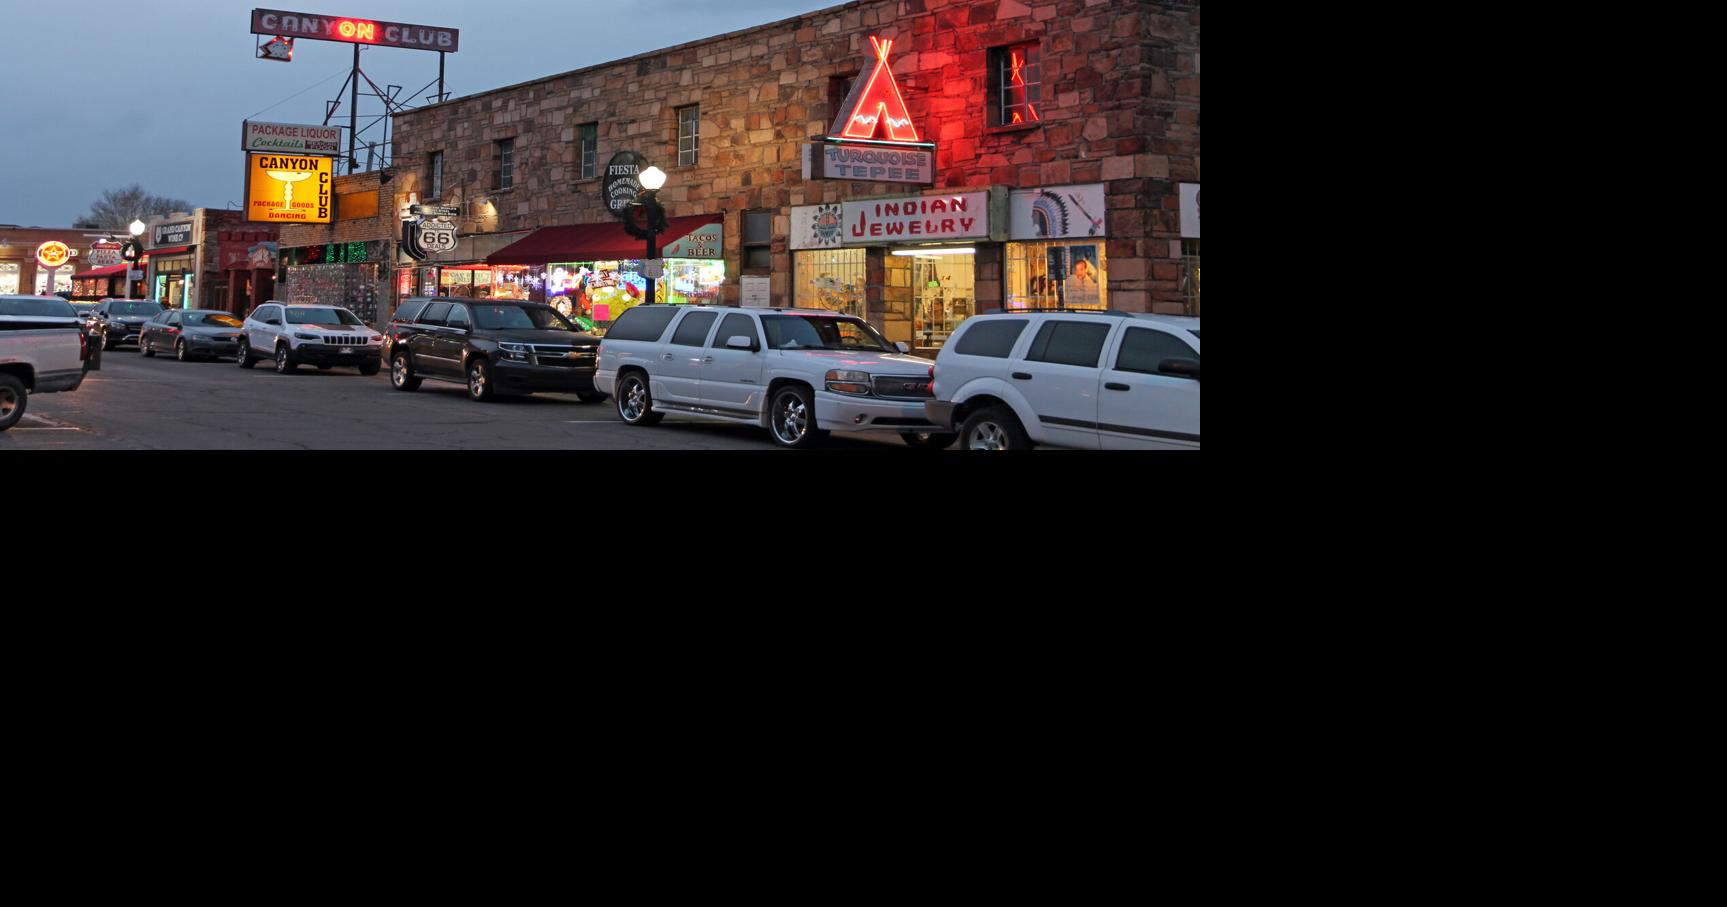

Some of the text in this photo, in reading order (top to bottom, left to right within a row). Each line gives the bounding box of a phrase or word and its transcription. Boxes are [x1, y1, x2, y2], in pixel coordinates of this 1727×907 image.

[261, 14, 453, 47] CANYON CLUB
[252, 124, 337, 140] PACKAGE LIQUOR
[252, 137, 304, 149] Cocktails
[259, 156, 319, 171] CANYON
[825, 149, 927, 166] TURQUOISE
[609, 164, 640, 176] FIESTA
[835, 164, 920, 180] TEPEE
[608, 177, 641, 193] HOMEMADE
[610, 187, 637, 198] COOKING
[318, 172, 328, 218] CLUB
[875, 198, 968, 217] INDIAN
[268, 212, 307, 220] DANCING
[852, 211, 974, 237] JEWELRY
[424, 232, 449, 244] 66
[687, 234, 717, 242] TACOS
[688, 248, 716, 257] BEER
